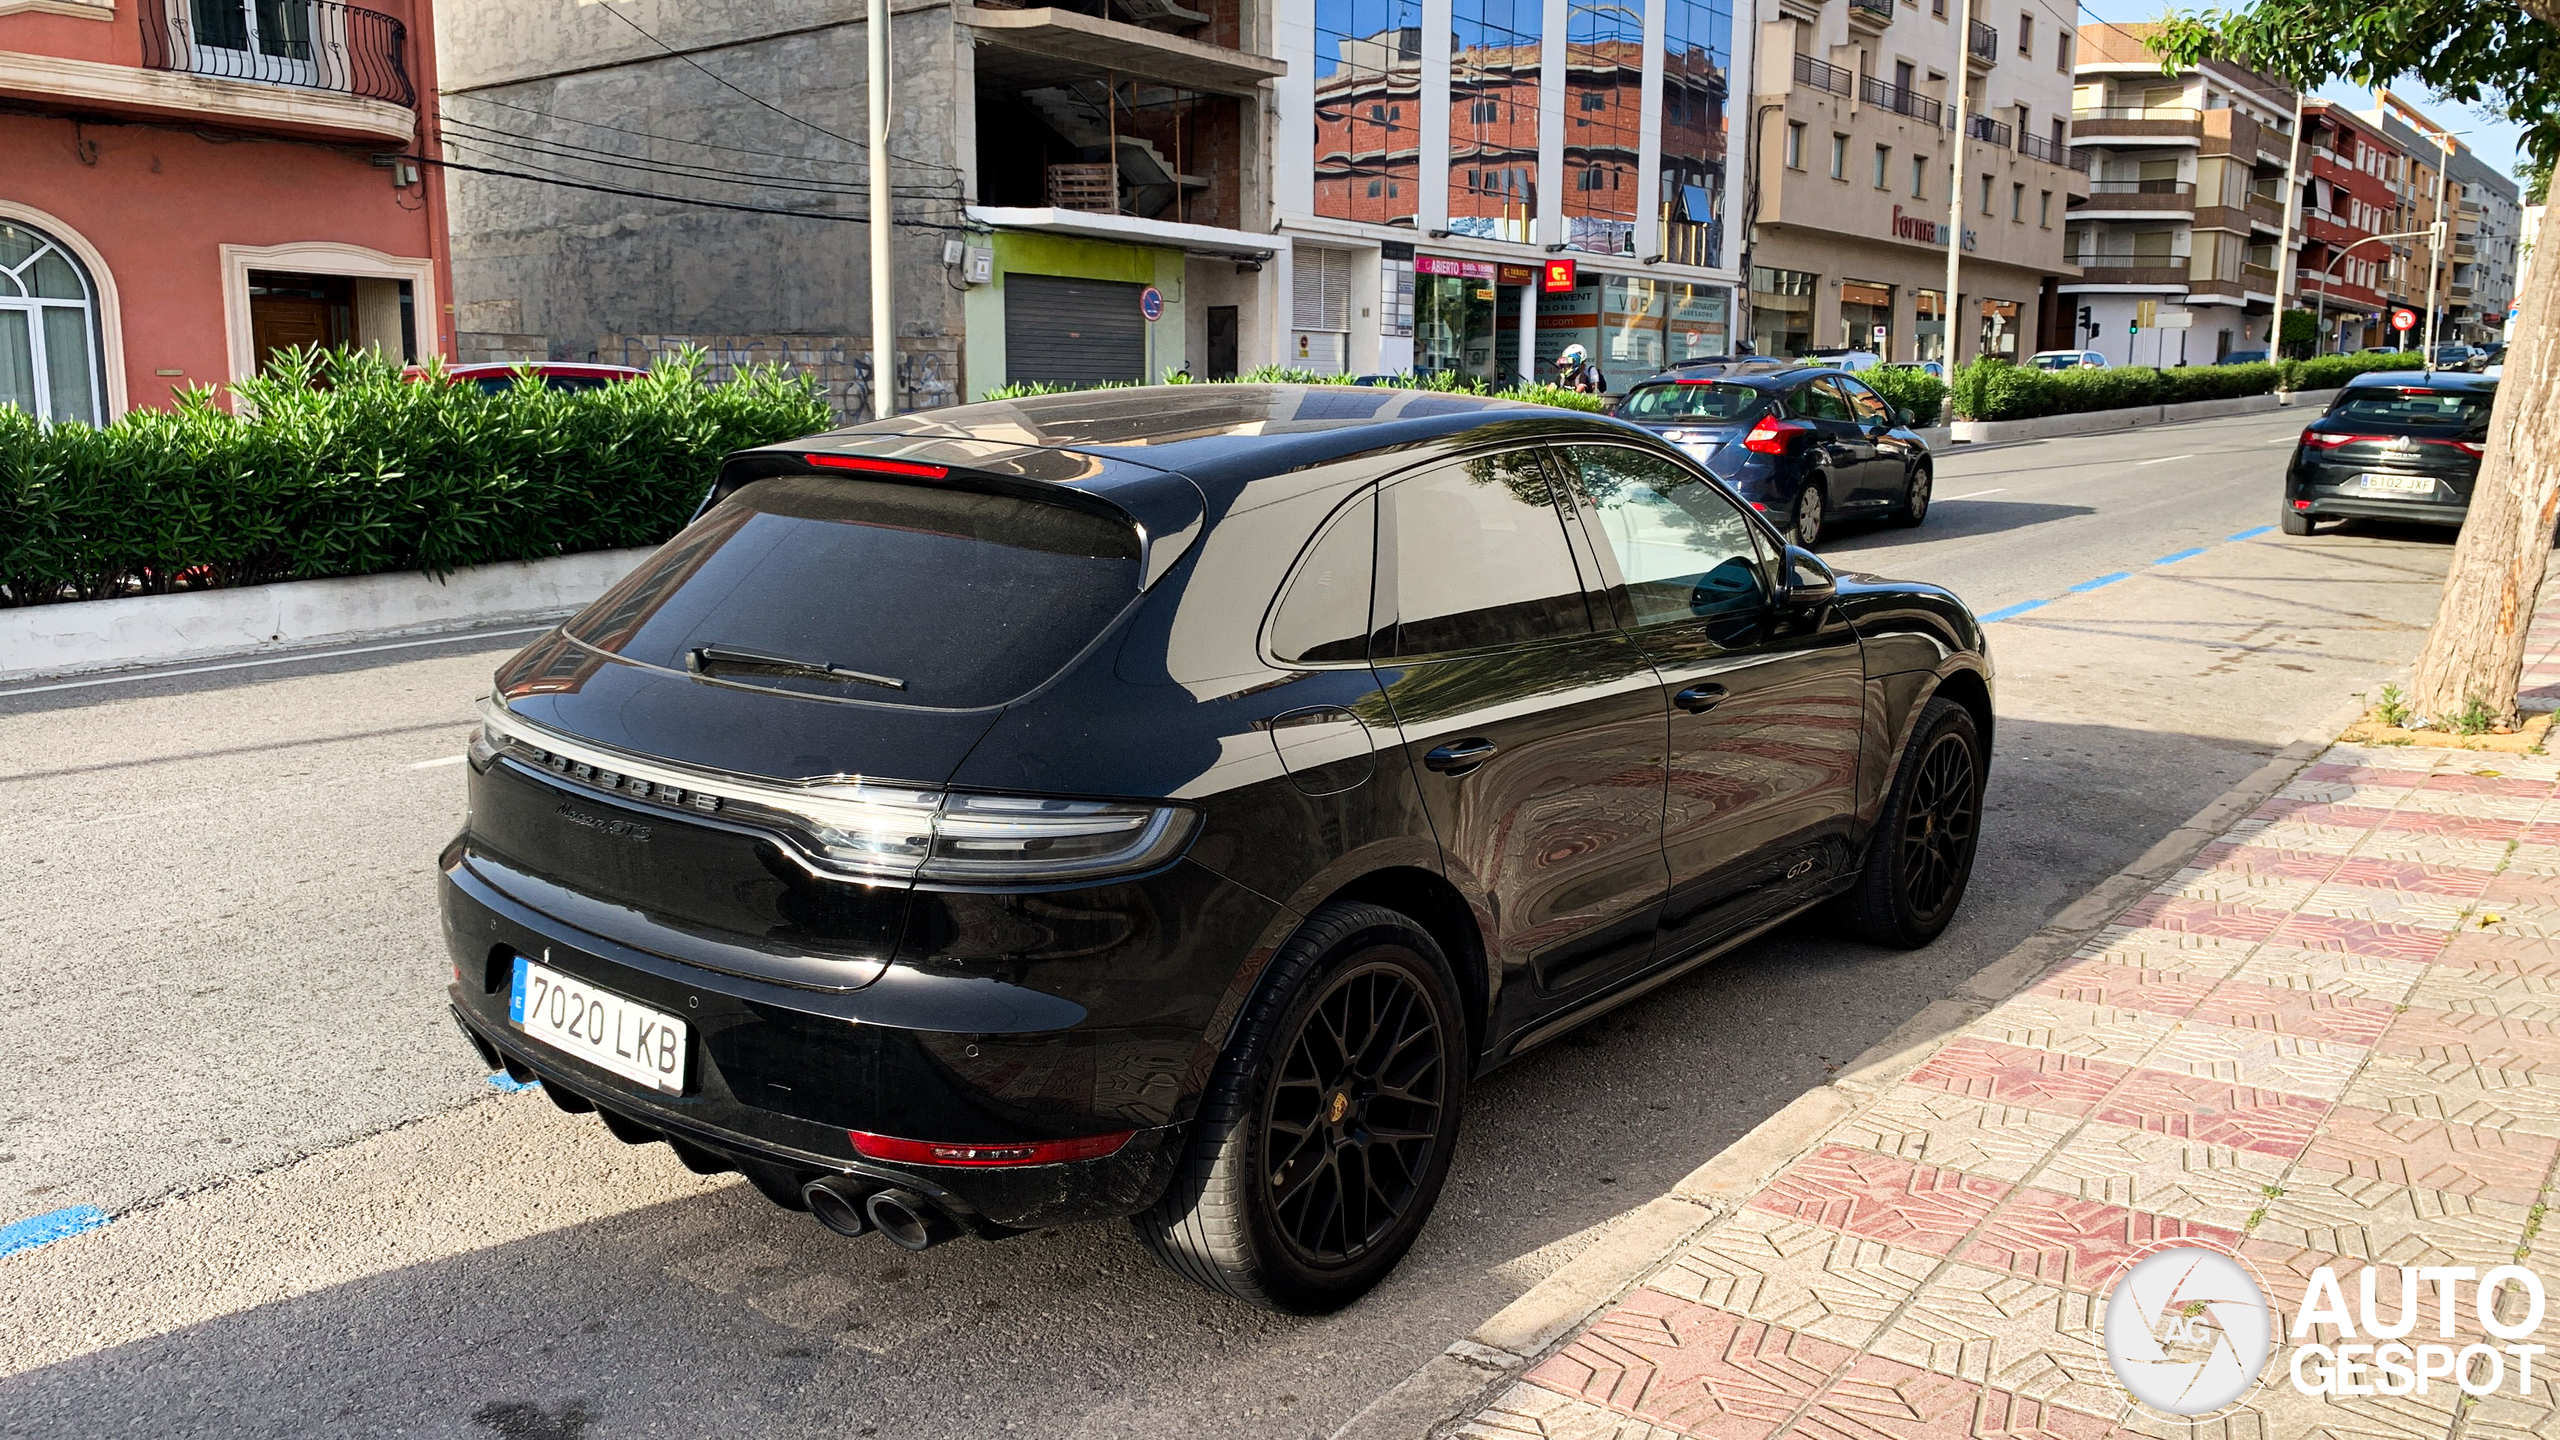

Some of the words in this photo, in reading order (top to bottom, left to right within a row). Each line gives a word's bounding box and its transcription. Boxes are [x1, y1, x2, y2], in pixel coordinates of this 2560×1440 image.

[1431, 260, 1459, 275] ABIERTO
[2370, 476, 2403, 488] 6102
[2407, 479, 2431, 491] JXF
[533, 748, 721, 812] PORSCHE
[610, 819, 653, 843] GTS
[1787, 857, 1815, 879] GTS
[515, 996, 522, 1009] E
[532, 975, 605, 1046] 7020
[616, 1009, 677, 1075] LKB
